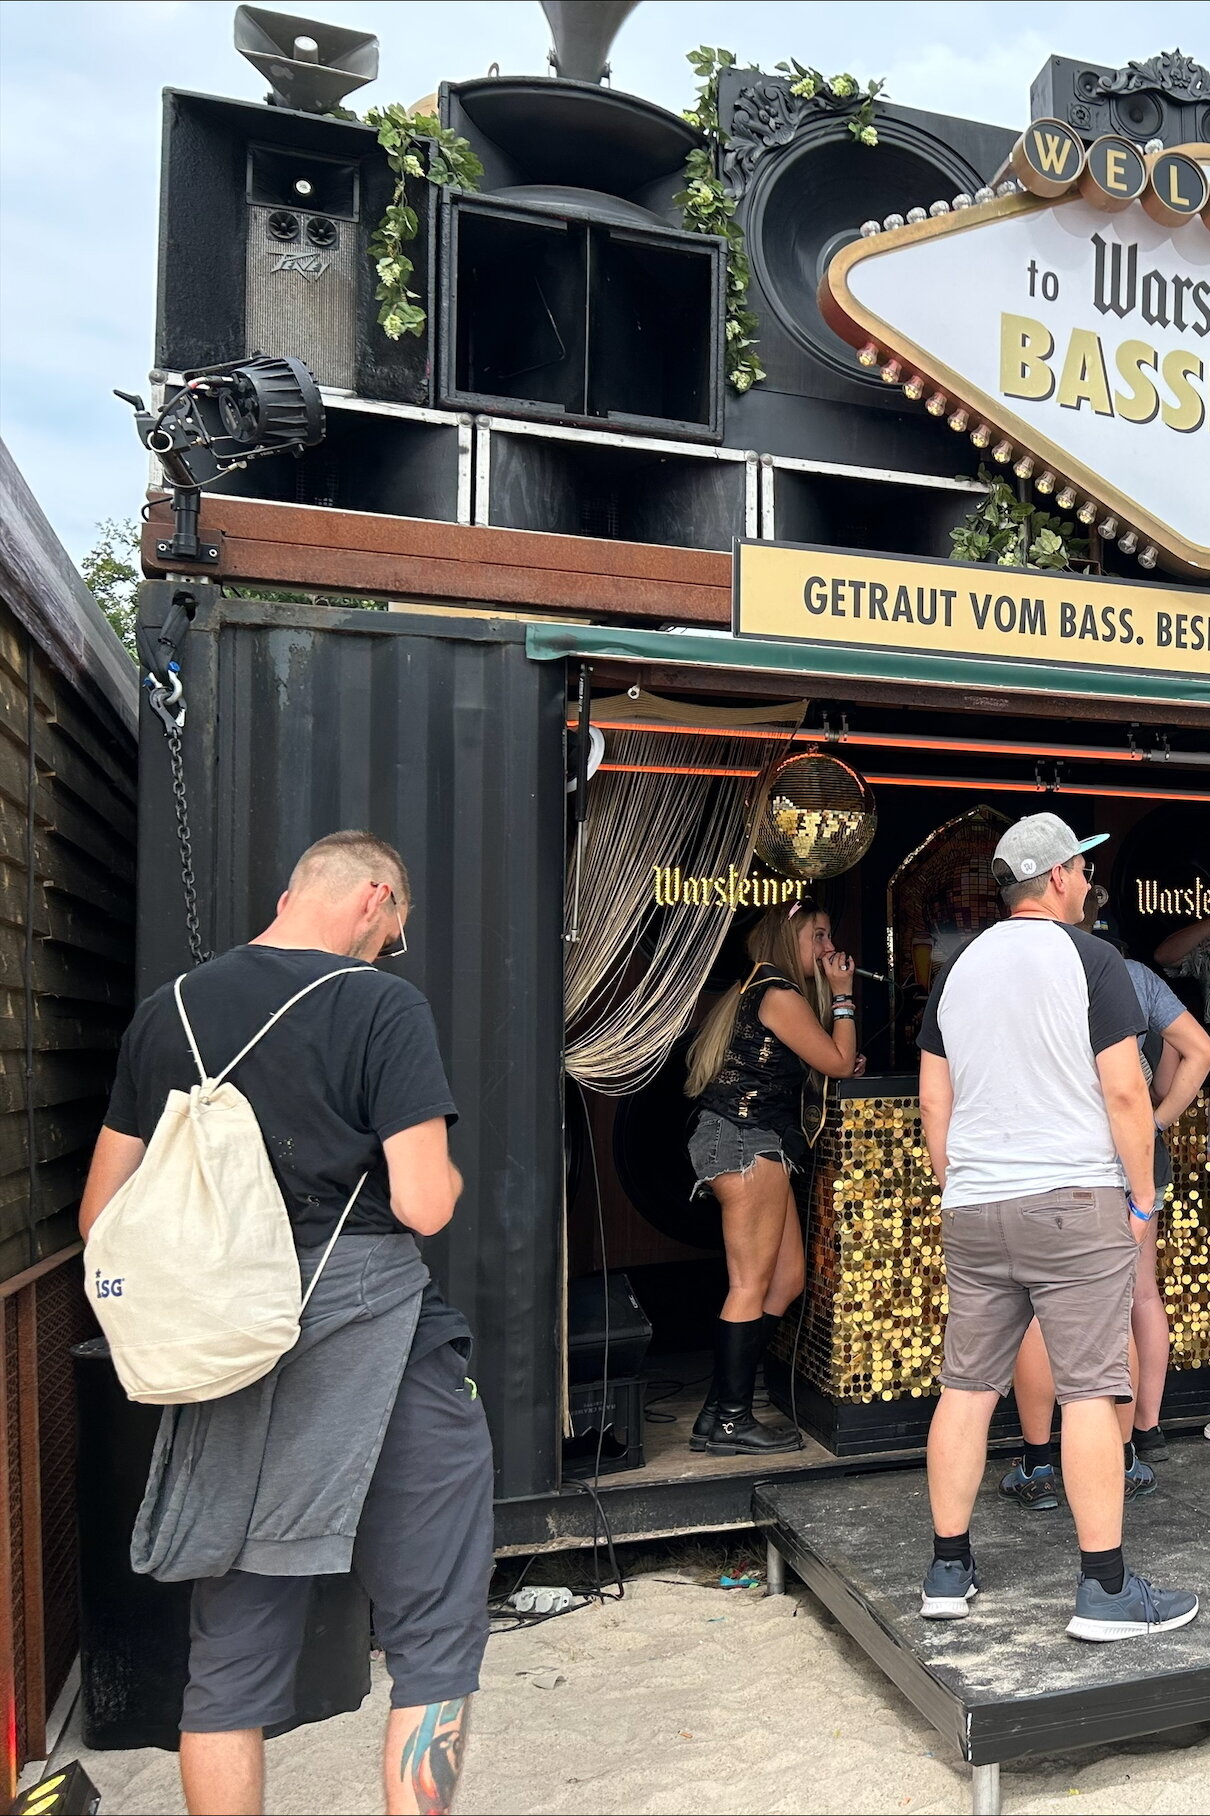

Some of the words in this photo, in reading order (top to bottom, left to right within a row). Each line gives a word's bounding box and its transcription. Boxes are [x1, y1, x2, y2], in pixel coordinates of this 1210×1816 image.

[1027, 260, 1060, 301] to
[803, 575, 957, 627] GETRAUT
[969, 592, 1047, 636] VOM
[1060, 601, 1144, 645] BASS.
[653, 864, 807, 912] Warsteiner
